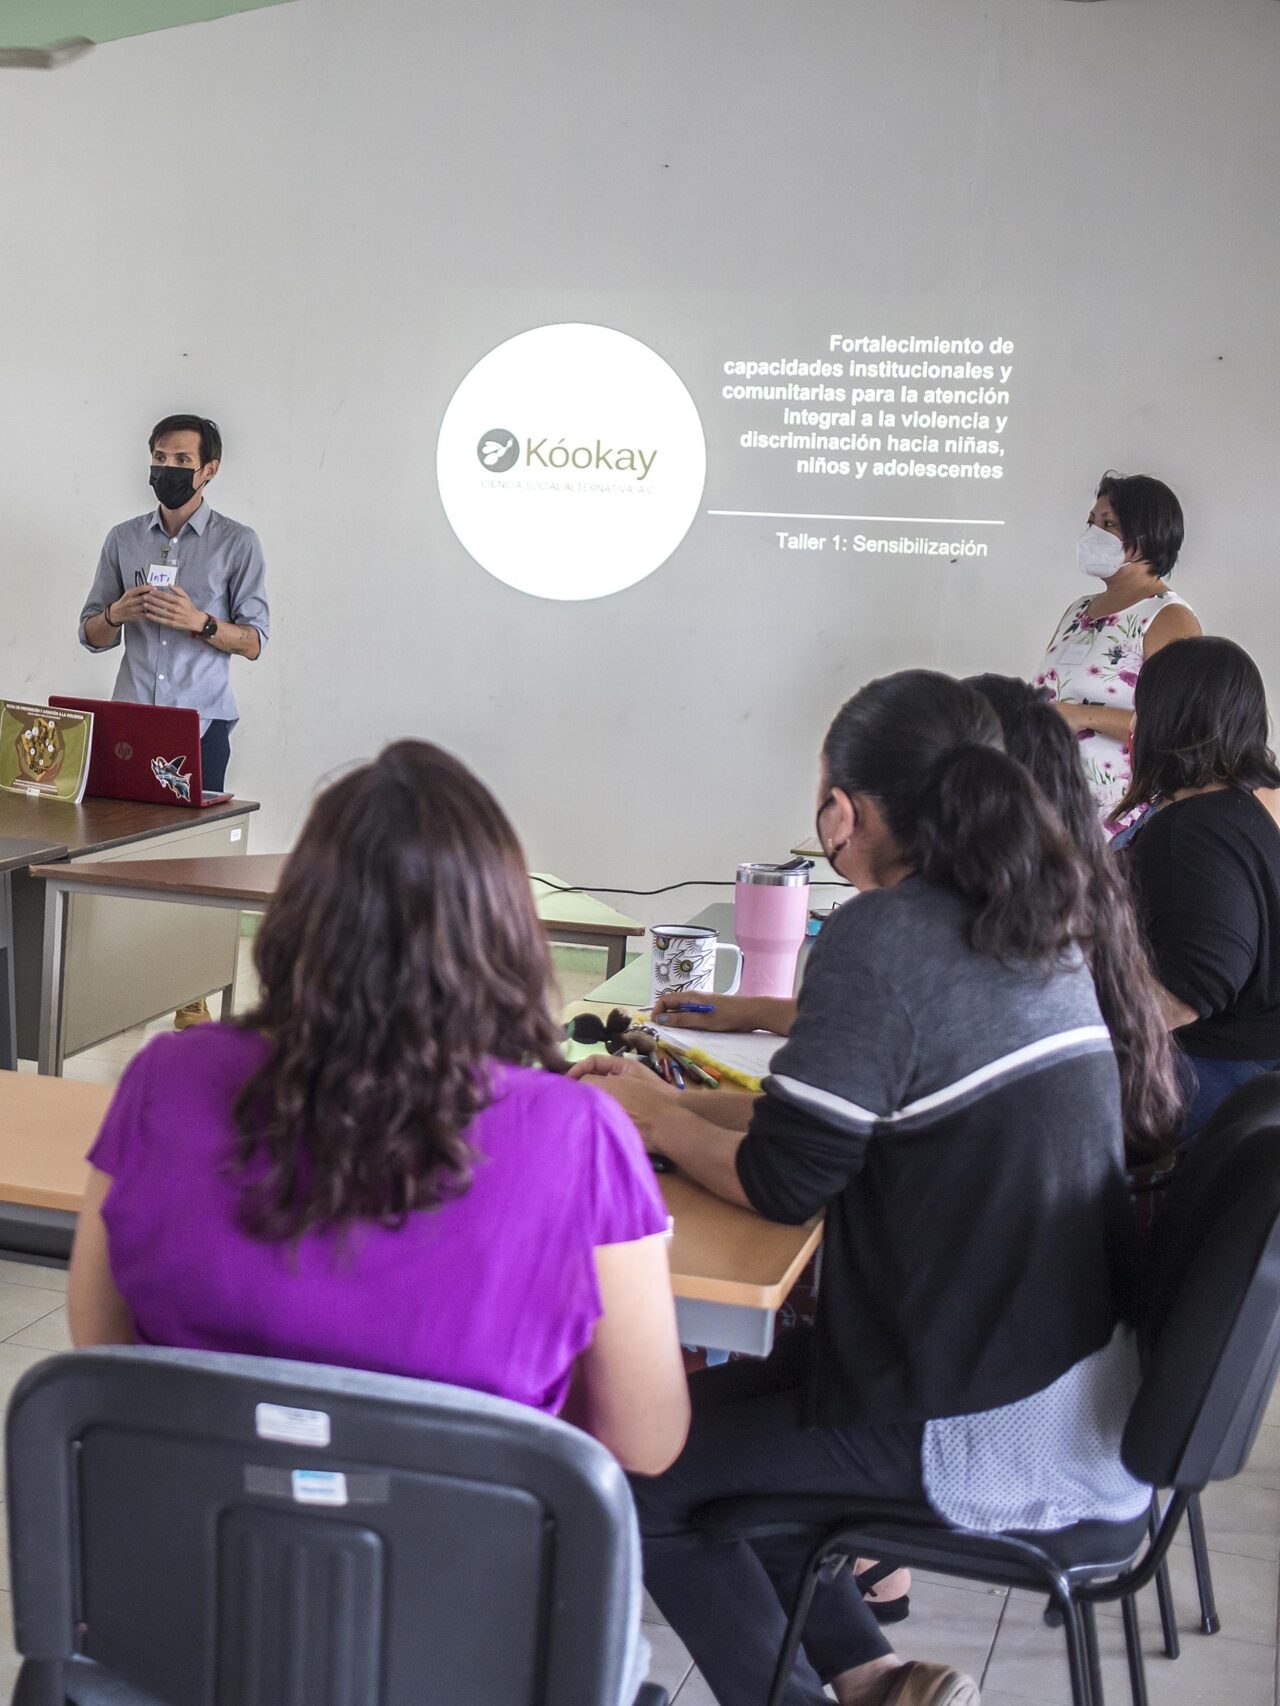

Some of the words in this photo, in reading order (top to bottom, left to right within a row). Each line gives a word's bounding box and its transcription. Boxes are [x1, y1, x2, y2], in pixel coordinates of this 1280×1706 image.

[829, 334, 984, 355] Fortalecimiento
[989, 336, 1015, 356] de
[723, 358, 843, 380] capacidades
[849, 360, 994, 380] institucionales
[999, 365, 1013, 384] y
[721, 383, 846, 402] comunitarias
[851, 388, 895, 407] para
[900, 385, 918, 403] la
[923, 386, 1010, 405] atención
[783, 407, 856, 430] integral
[860, 412, 873, 427] a
[878, 409, 896, 428] la
[901, 410, 990, 430] violencia
[995, 415, 1009, 434] y
[739, 430, 882, 452] discriminación
[887, 433, 939, 453] hacia
[944, 435, 1005, 457] niñas,
[525, 437, 658, 481] Kóokay
[796, 456, 850, 476] niños
[855, 461, 868, 480] y
[872, 459, 1004, 480] adolescentes
[775, 531, 827, 551] Taller
[832, 534, 848, 552] 1:
[852, 534, 988, 557] Sensibilización
